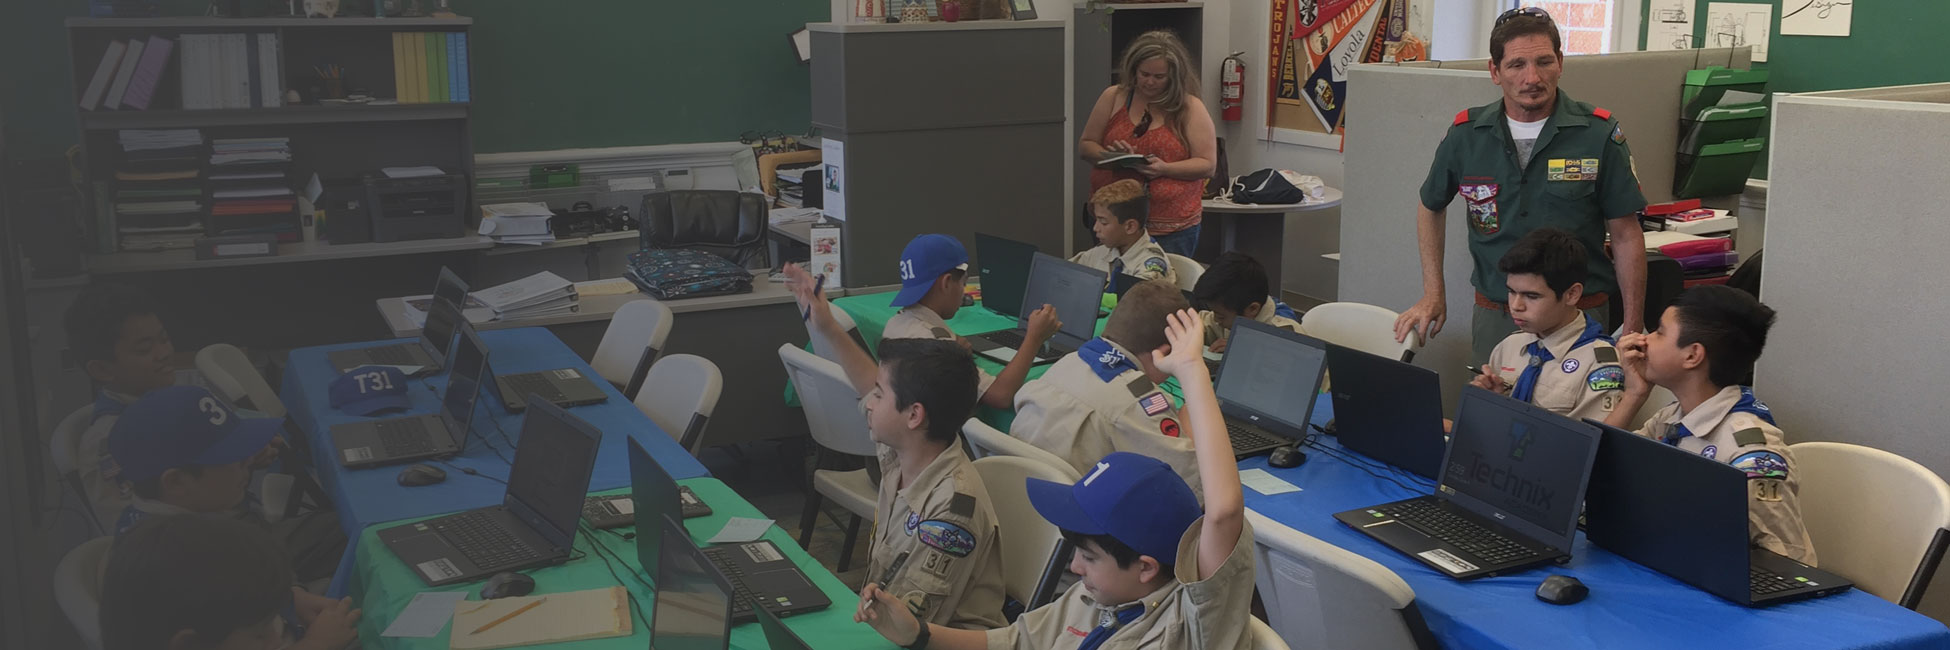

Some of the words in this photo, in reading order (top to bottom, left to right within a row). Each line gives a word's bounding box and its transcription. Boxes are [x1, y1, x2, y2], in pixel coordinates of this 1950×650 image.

[1272, 0, 1286, 78] TROJANS
[1333, 29, 1366, 77] Loyola
[900, 259, 915, 280] 31
[354, 372, 394, 394] T31
[1469, 450, 1555, 510] Technix
[1757, 482, 1778, 499] 31
[927, 553, 951, 574] 31
